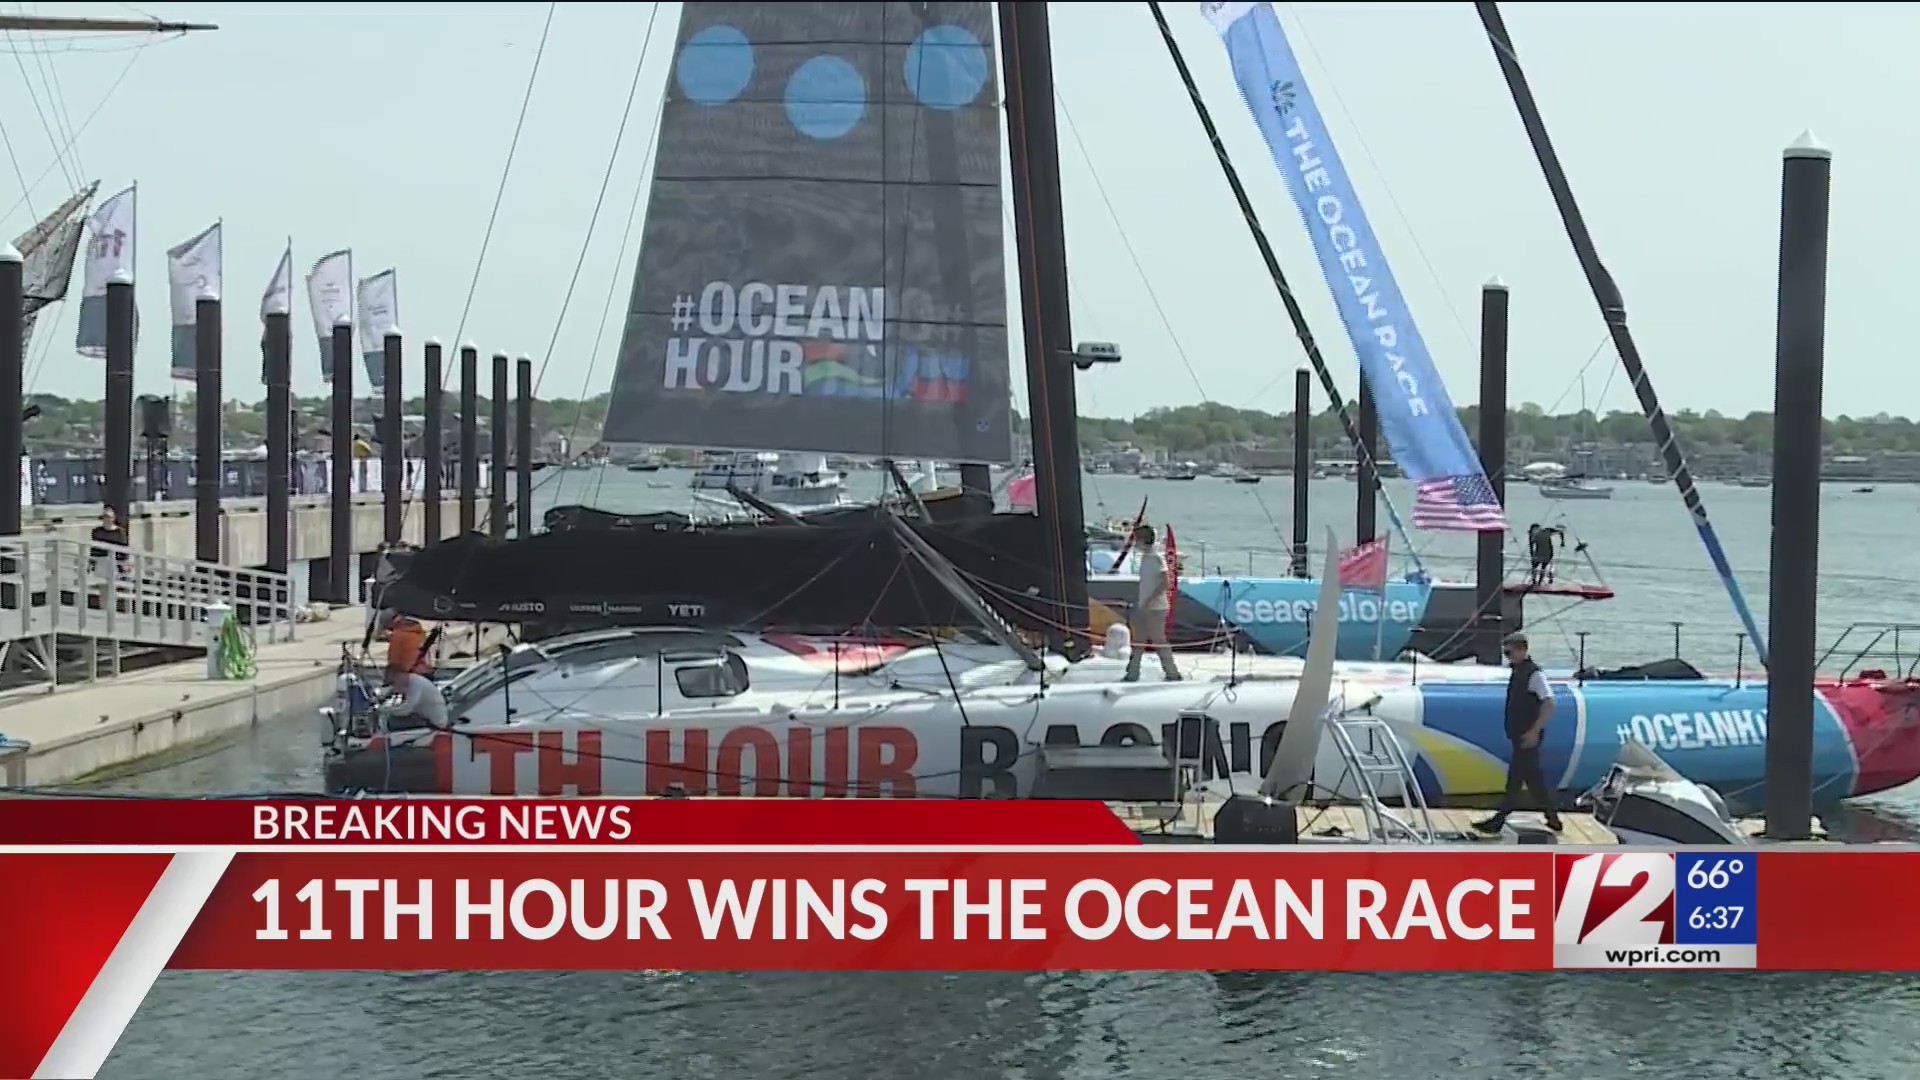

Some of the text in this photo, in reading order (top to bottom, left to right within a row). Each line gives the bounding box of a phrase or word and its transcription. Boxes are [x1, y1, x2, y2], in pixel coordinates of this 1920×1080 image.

[1286, 115, 1428, 417] THE OCEAN RACE
[670, 281, 884, 341] #OCEAN
[663, 337, 804, 395] HOUR
[667, 604, 705, 617] YETI
[1235, 592, 1420, 622] seaelorer
[646, 726, 918, 798] HOUR
